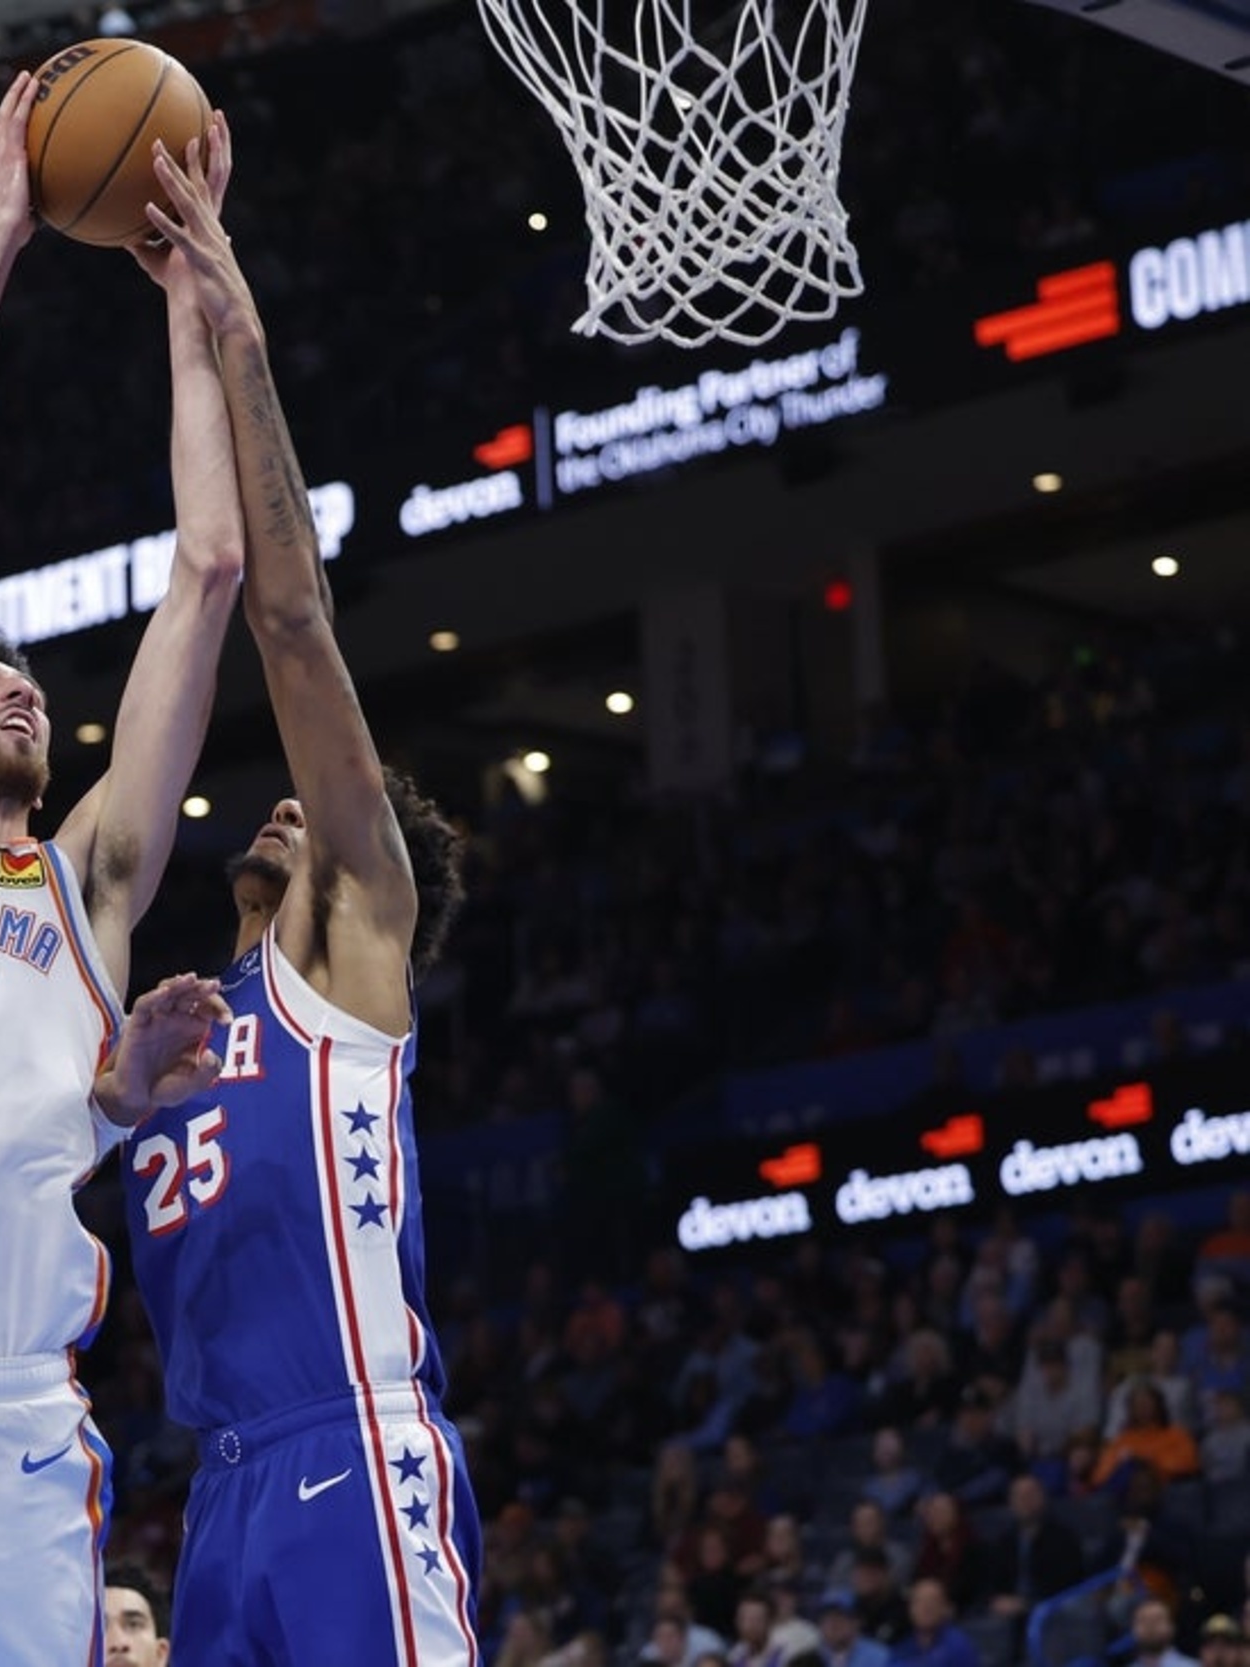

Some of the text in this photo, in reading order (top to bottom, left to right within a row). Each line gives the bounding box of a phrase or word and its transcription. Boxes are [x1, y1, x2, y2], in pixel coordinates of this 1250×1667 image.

[555, 327, 859, 455] Founding Partner of
[399, 471, 523, 536] devon
[133, 1105, 231, 1237] 25
[836, 1163, 975, 1224] devon
[1000, 1133, 1143, 1195] devon
[676, 1191, 811, 1251] devon
